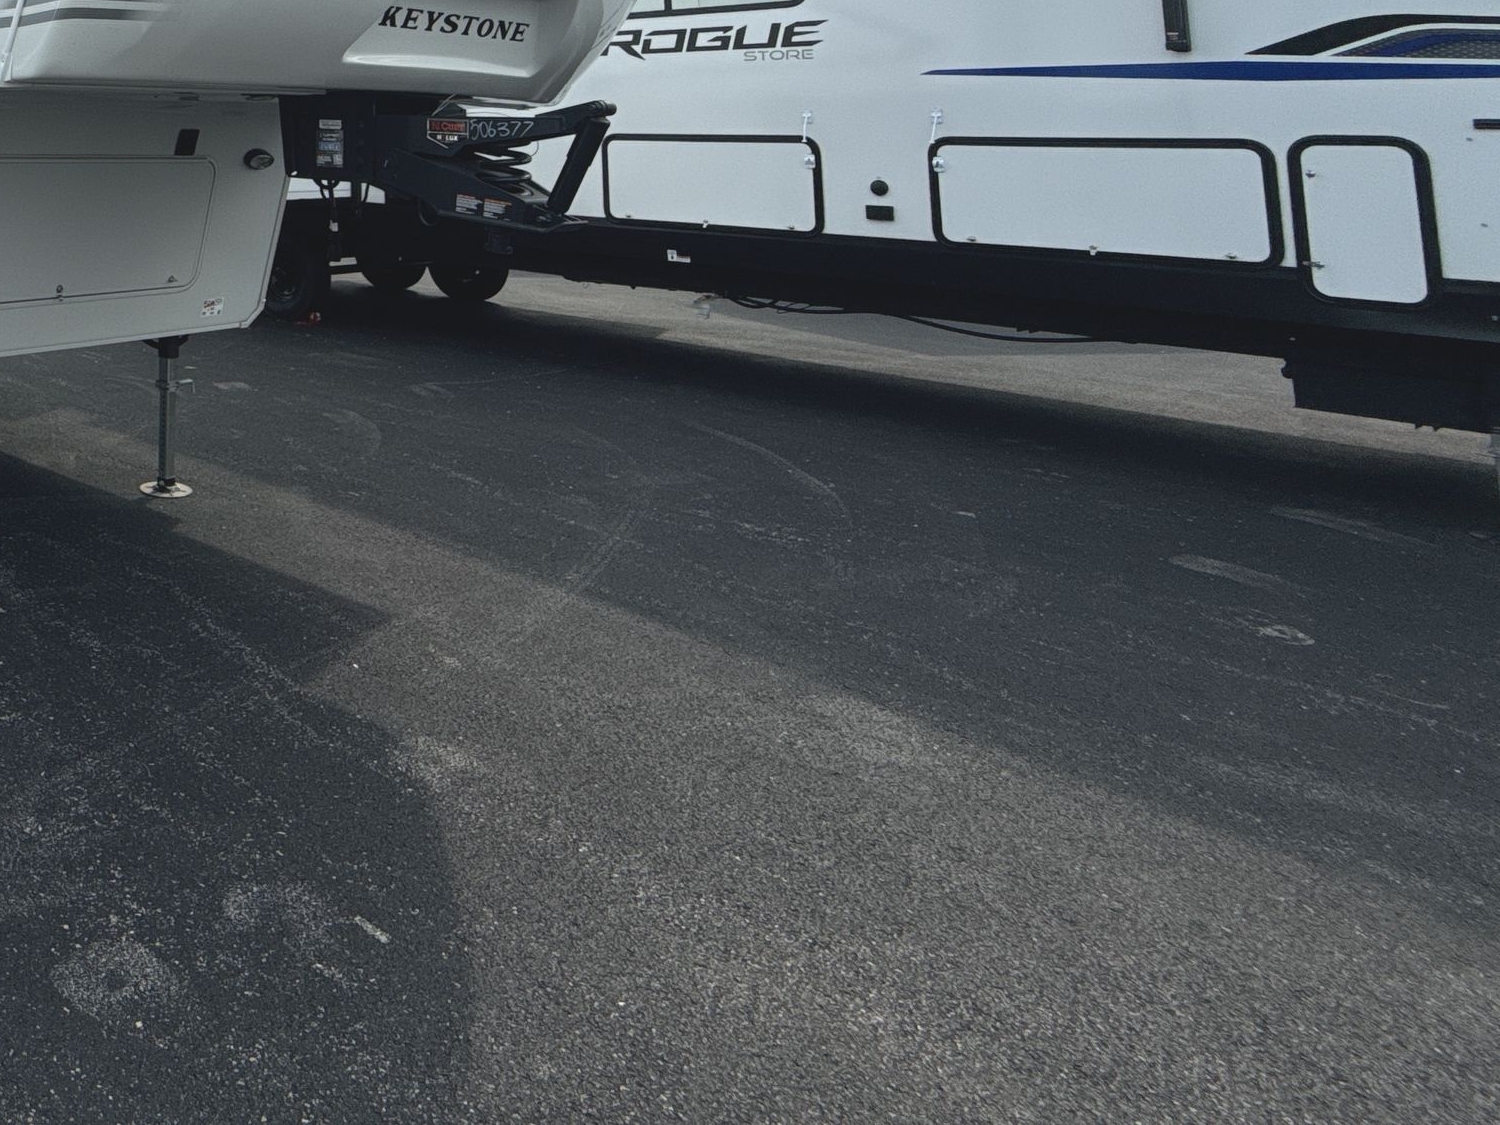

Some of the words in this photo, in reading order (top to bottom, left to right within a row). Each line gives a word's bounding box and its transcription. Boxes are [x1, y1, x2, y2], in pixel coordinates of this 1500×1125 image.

[378, 6, 530, 42] KEYSTONE
[601, 19, 829, 61] ROGUE
[743, 49, 815, 62] STORE
[470, 119, 535, 141] 506377
